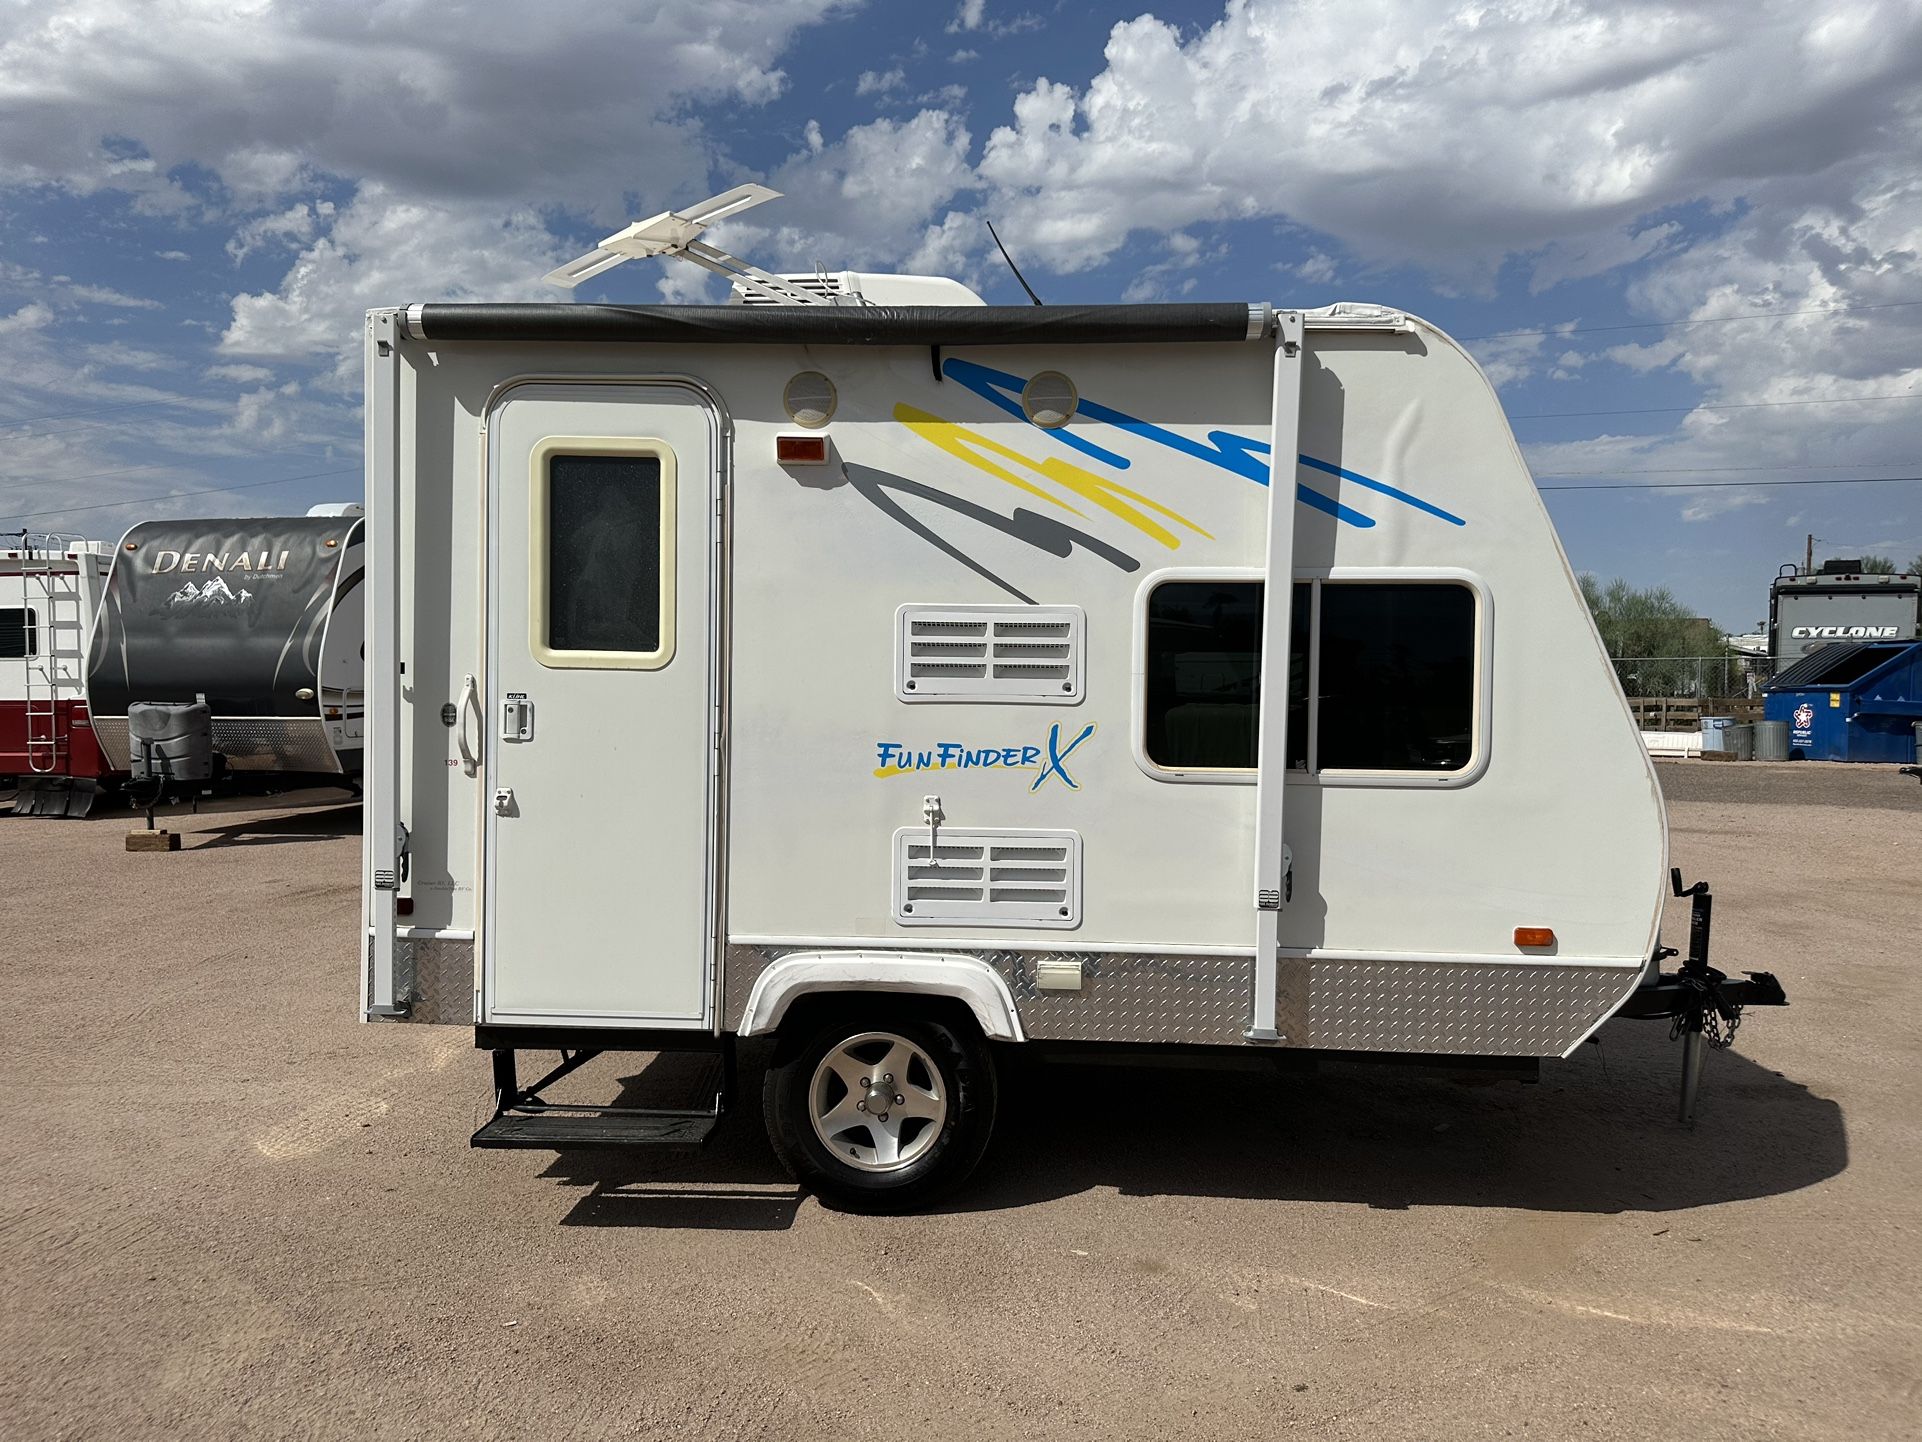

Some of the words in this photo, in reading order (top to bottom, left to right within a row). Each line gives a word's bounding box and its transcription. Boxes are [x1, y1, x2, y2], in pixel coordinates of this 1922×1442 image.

[152, 550, 290, 574] DENALI
[1791, 626, 1898, 639] CYCLONE
[444, 759, 458, 767] 139
[1030, 722, 1096, 792] X
